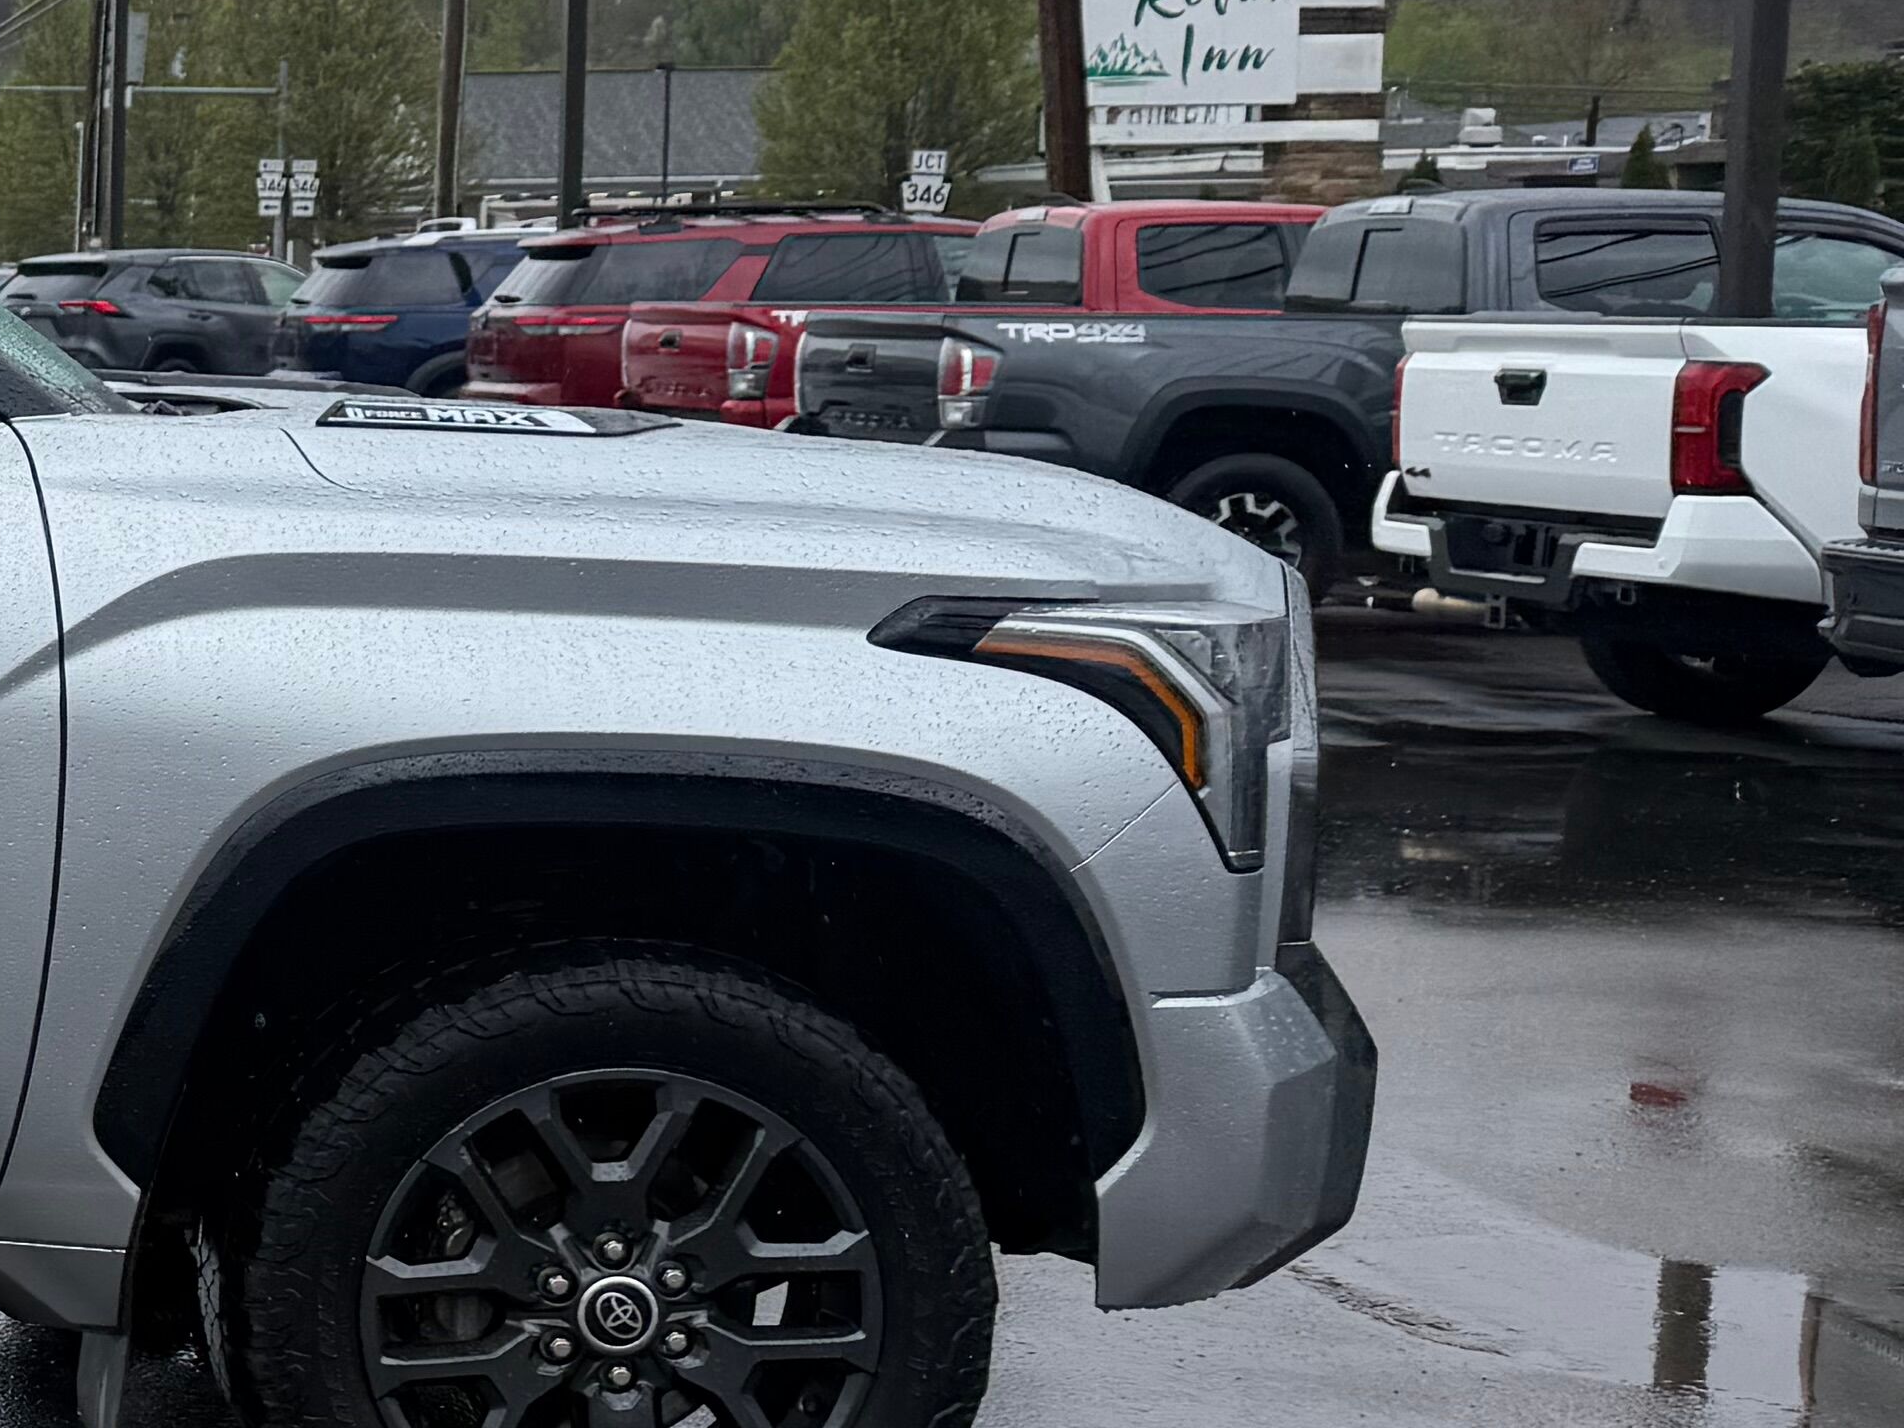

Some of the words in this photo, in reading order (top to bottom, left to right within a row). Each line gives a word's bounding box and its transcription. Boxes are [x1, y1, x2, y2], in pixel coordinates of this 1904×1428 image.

[1181, 24, 1276, 86] Inn
[914, 153, 944, 169] JCT
[906, 183, 945, 205] 346
[996, 322, 1076, 343] TRD
[426, 408, 535, 427] MAX
[1432, 431, 1619, 464] TACOMA
